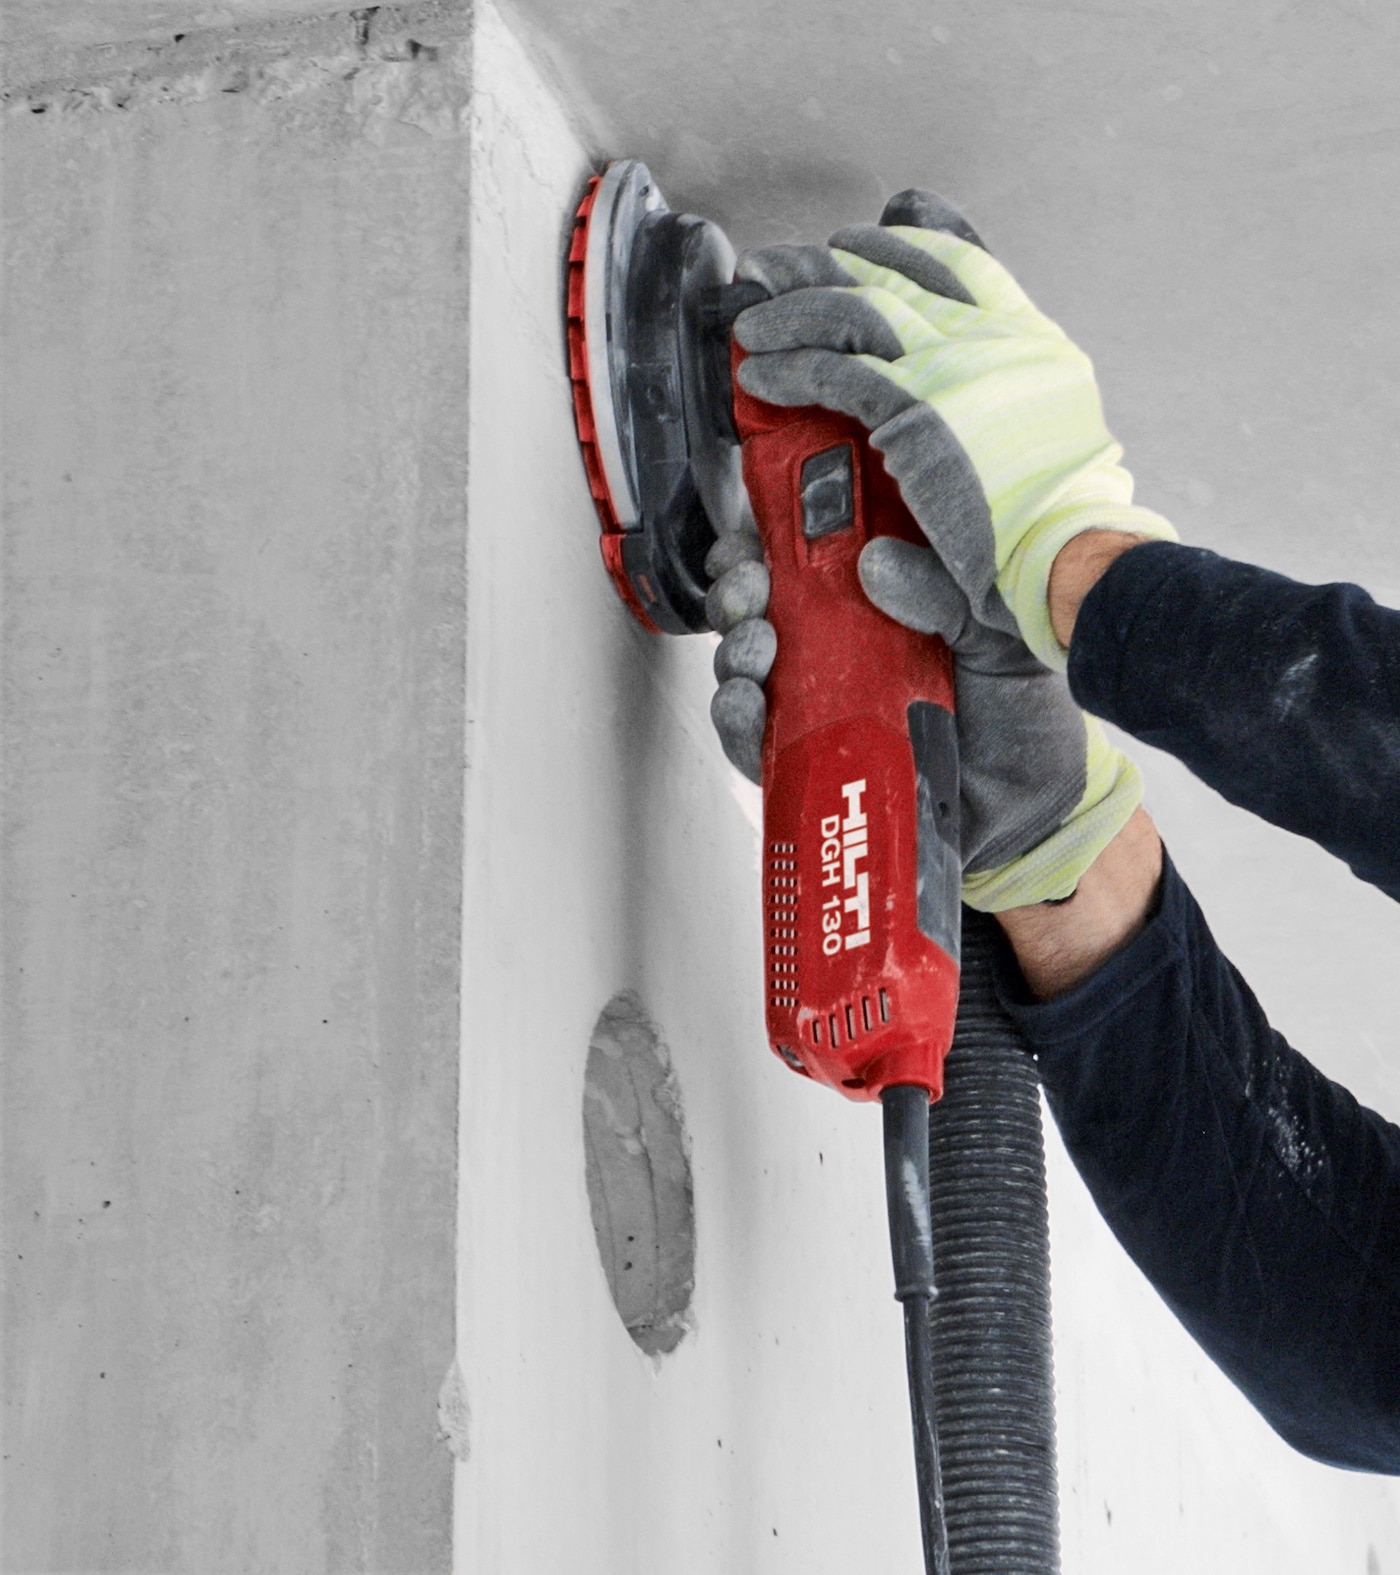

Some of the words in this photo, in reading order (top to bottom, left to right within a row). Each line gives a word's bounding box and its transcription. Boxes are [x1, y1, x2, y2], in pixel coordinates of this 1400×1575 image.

[820, 814, 842, 888] DGH
[841, 778, 871, 951] HILTI
[821, 895, 843, 957] 130
